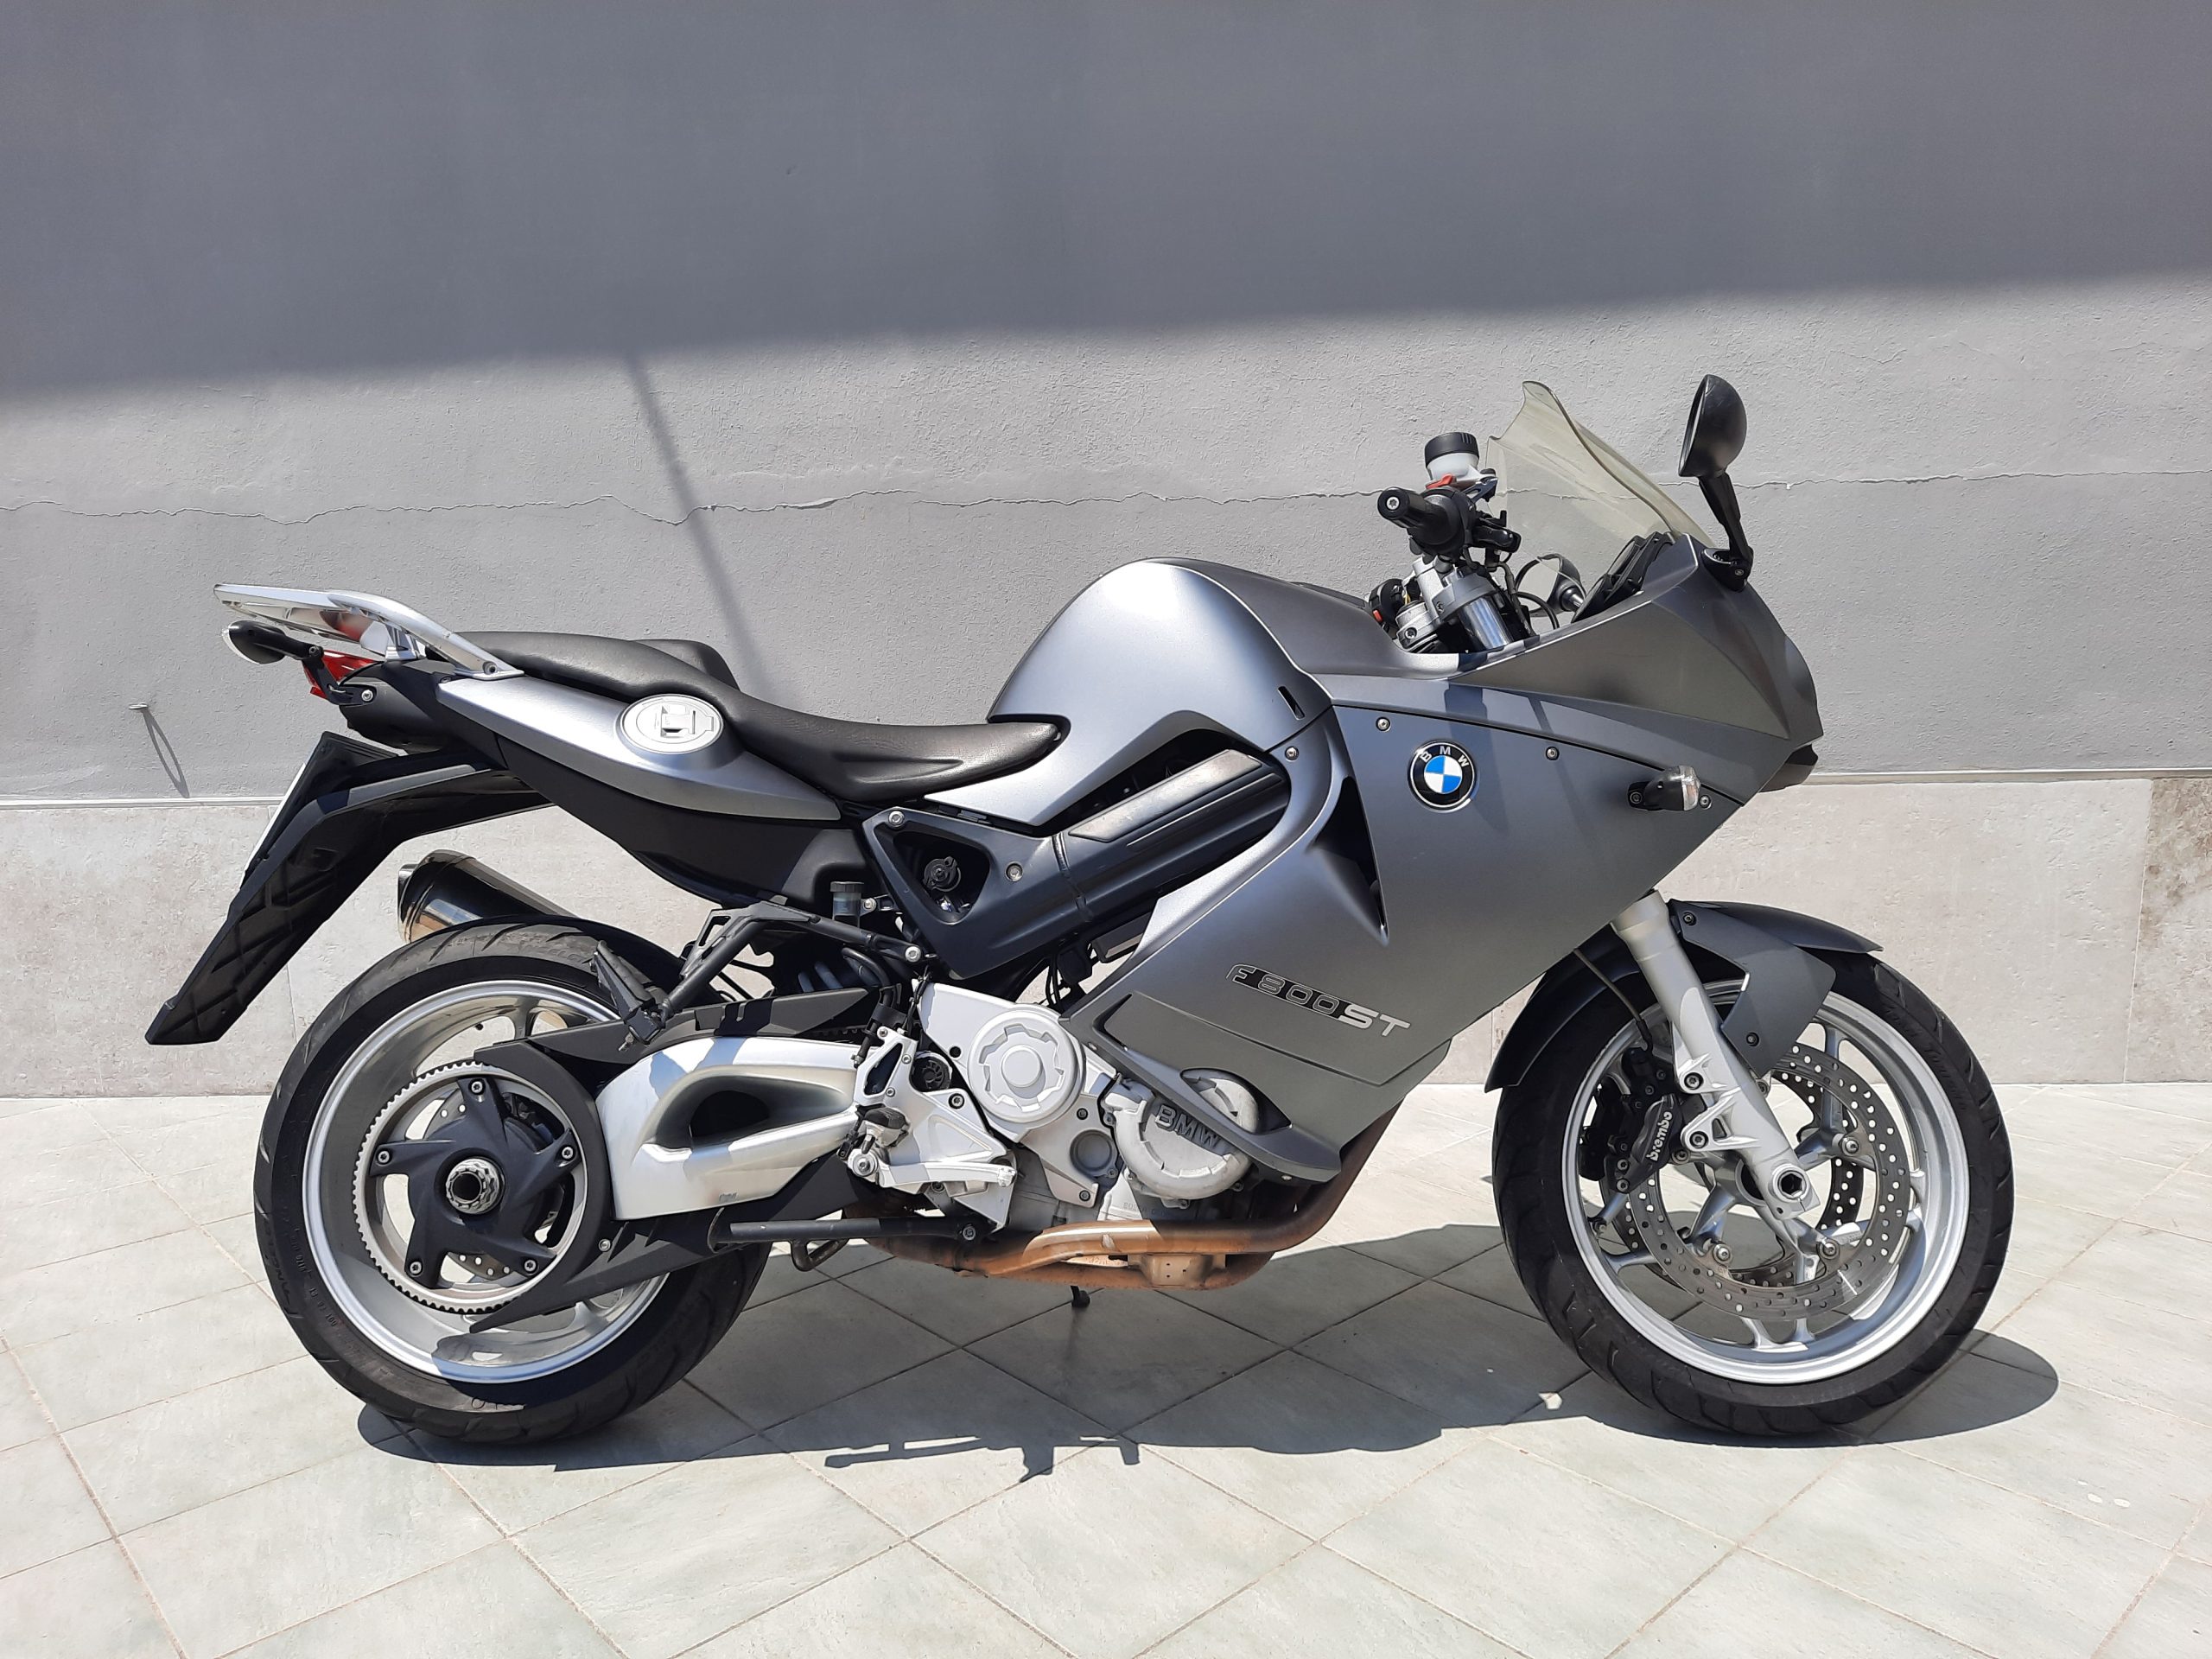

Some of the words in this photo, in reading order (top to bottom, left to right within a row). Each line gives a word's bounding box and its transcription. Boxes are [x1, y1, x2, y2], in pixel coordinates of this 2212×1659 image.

[1420, 746, 1470, 767] BMW
[1154, 1103, 1222, 1150] BMW
[1646, 1111, 1673, 1161] brembo
